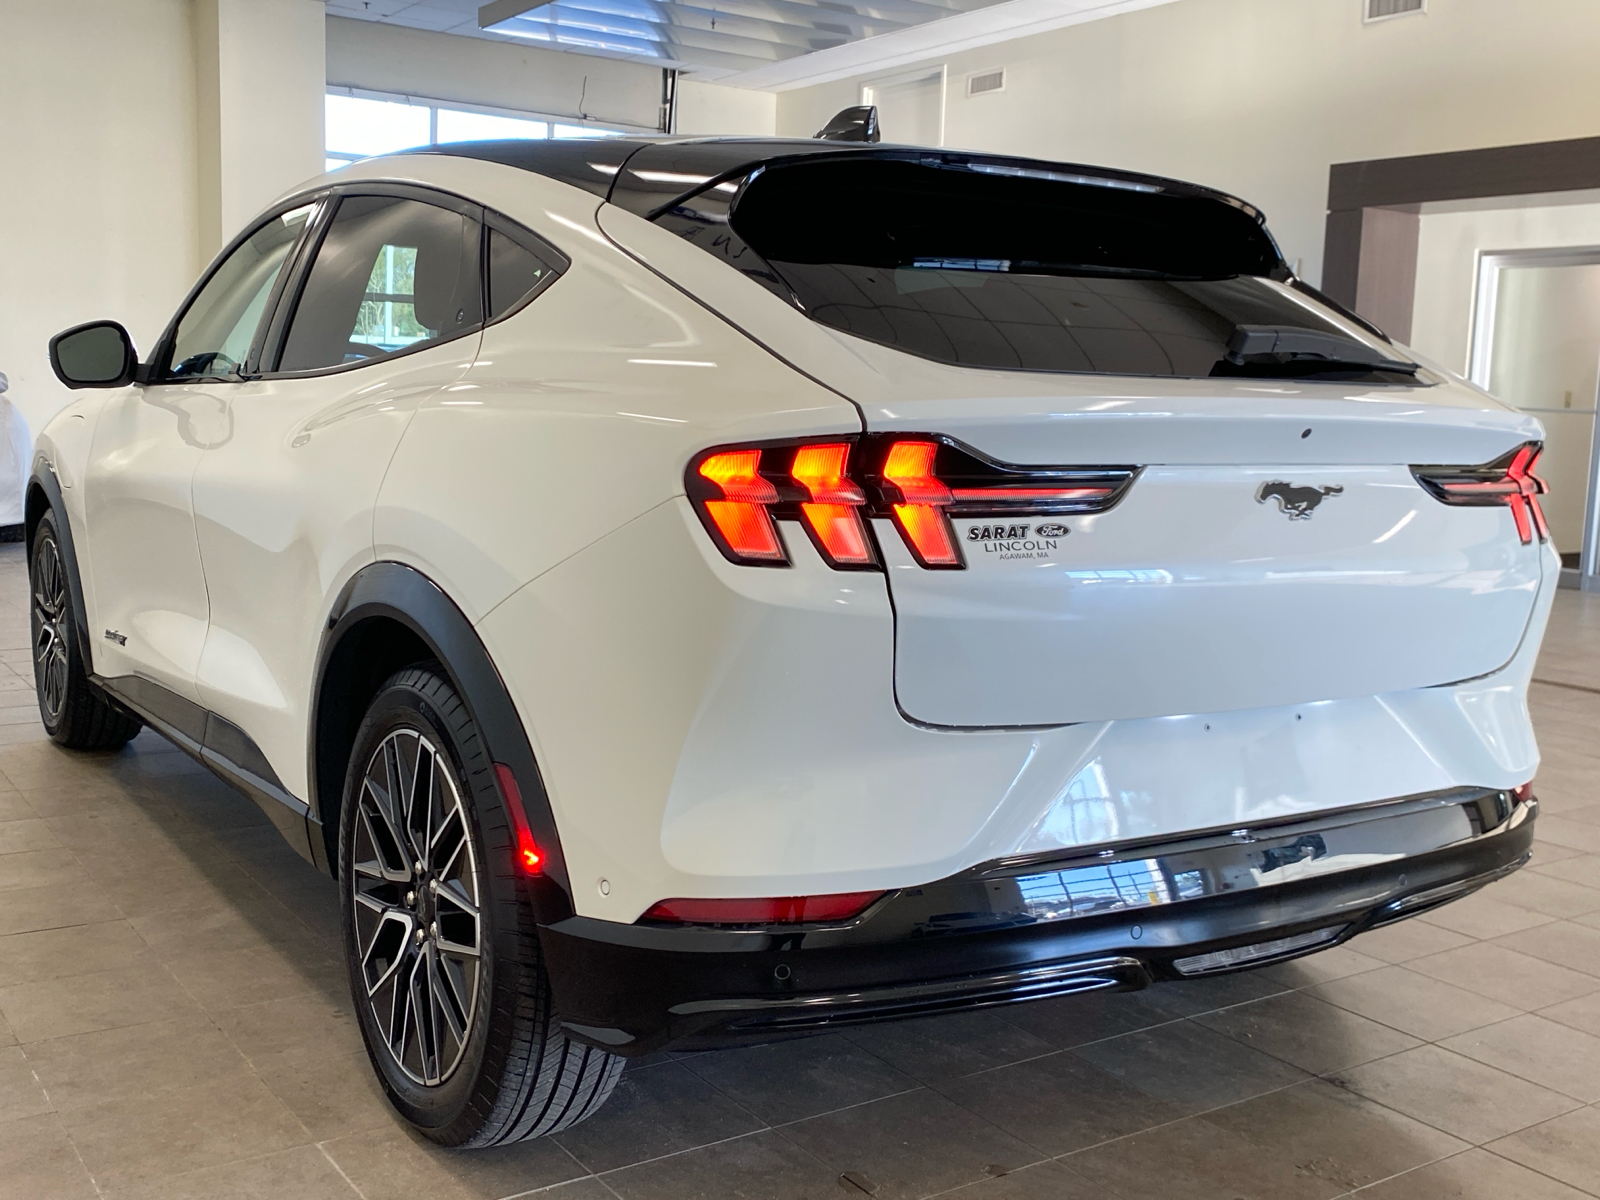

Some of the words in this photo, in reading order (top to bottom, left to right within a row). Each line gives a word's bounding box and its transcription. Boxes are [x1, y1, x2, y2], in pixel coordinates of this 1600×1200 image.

[968, 524, 1030, 541] SARAT
[1040, 525, 1066, 537] Ford
[984, 540, 1057, 553] LINCOLN
[999, 552, 1036, 560] AGAWAM,
[1037, 551, 1049, 559] MA
